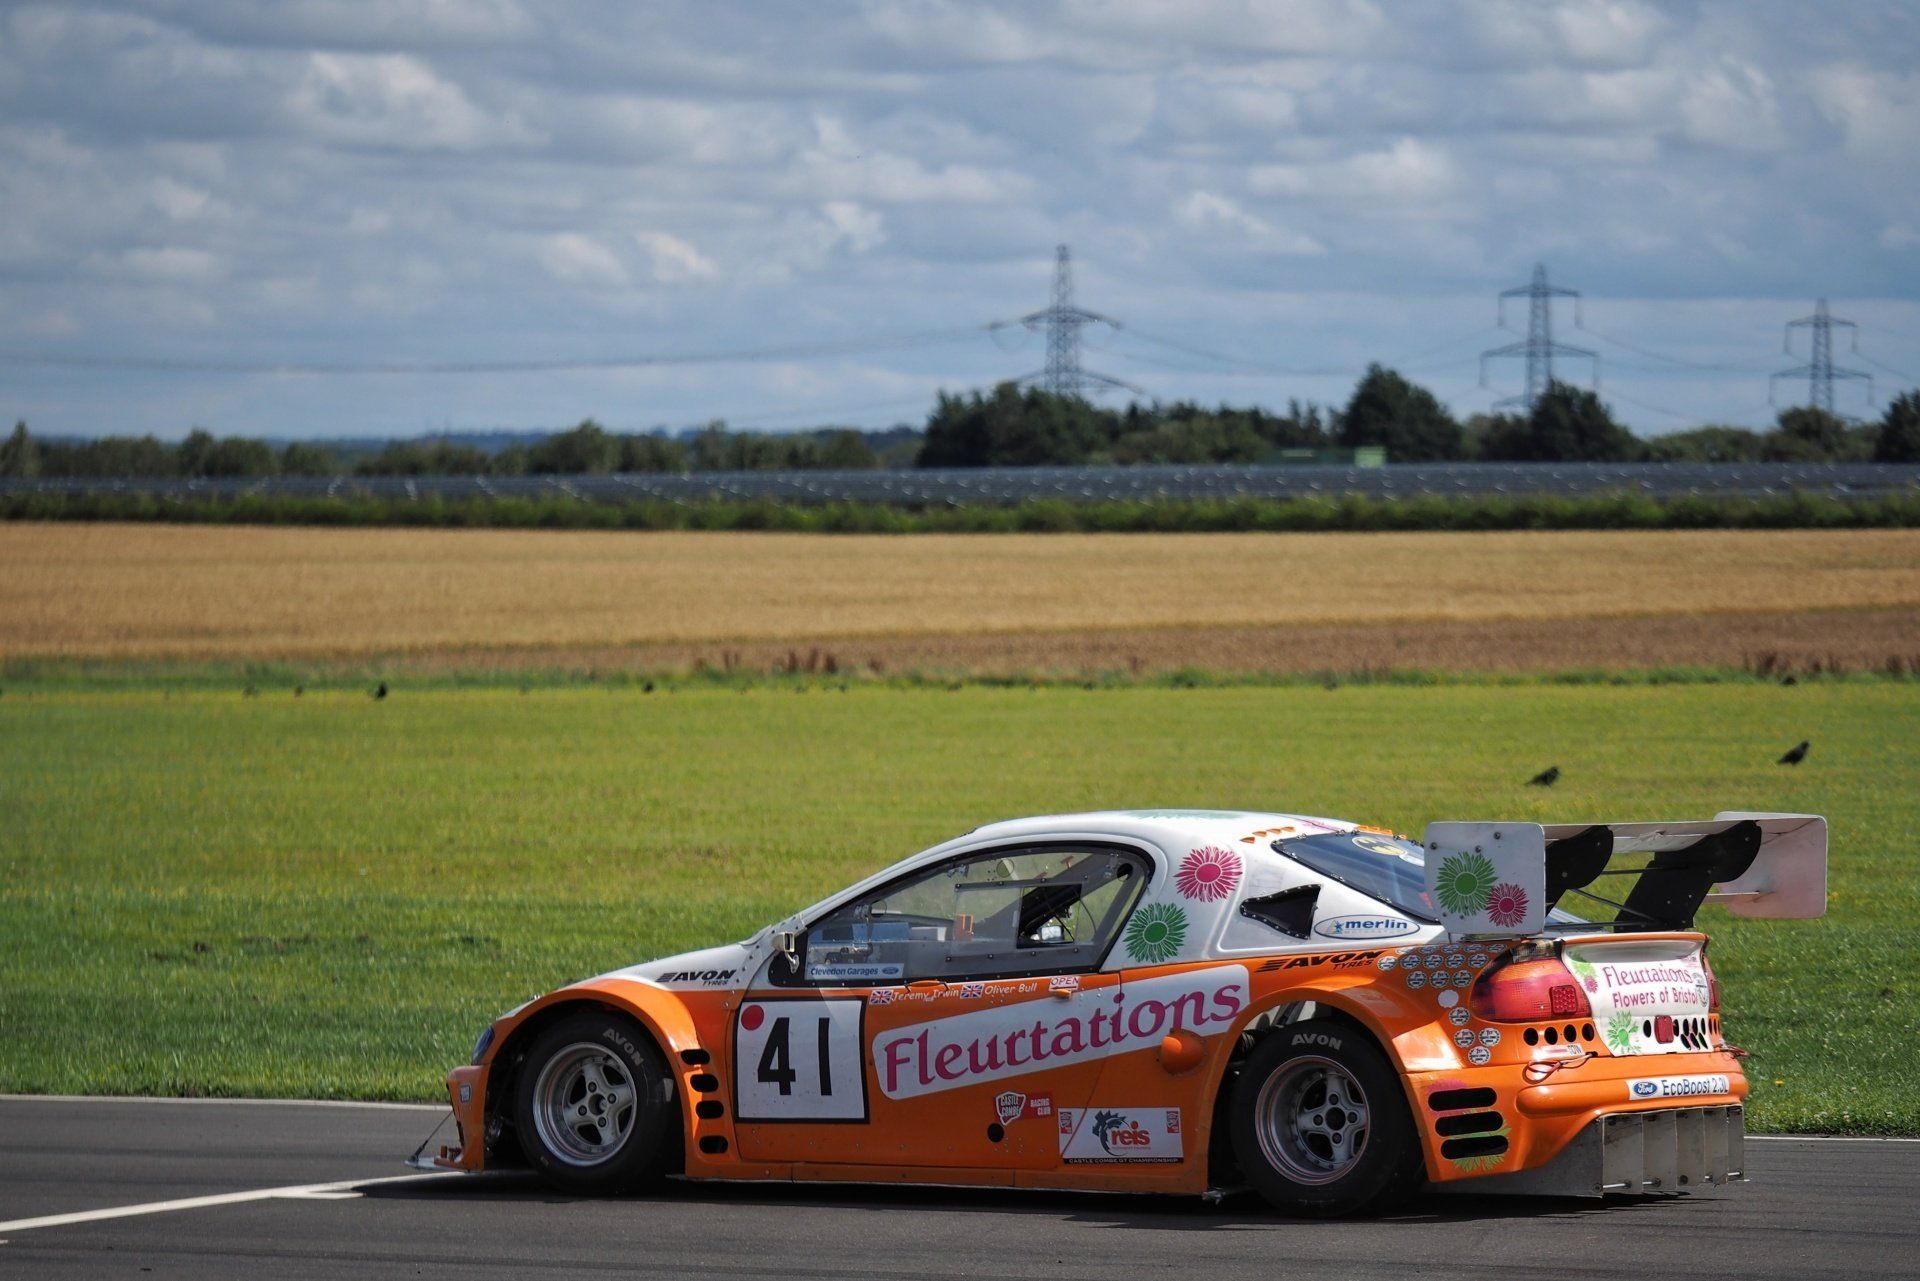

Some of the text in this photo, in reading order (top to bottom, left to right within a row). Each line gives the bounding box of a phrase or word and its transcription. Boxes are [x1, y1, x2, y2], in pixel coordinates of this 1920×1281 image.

[1345, 919, 1408, 929] merlin
[1283, 950, 1386, 969] AVON
[1333, 959, 1374, 971] TYRES
[673, 969, 738, 982] AVON
[810, 967, 846, 976] Clevedon
[847, 967, 879, 976] Garages
[1603, 963, 1694, 988] Fleurtations
[702, 979, 728, 987] TYRES
[1051, 977, 1079, 986] OPEN
[891, 991, 928, 1002] Jeremy
[932, 989, 960, 999] Irwin
[984, 984, 1016, 995] Oliver
[1018, 982, 1043, 993] Bull
[1612, 991, 1656, 1008] Flowers
[1660, 986, 1669, 1004] of
[1672, 987, 1699, 1005] Bristol
[884, 984, 1242, 1092] Fleurtations
[1291, 1033, 1343, 1050] AVON
[602, 1028, 645, 1067] AVON
[757, 1017, 832, 1096] 41
[1637, 1081, 1654, 1094] Ford
[1661, 1078, 1710, 1096] EcoBoost
[1000, 1095, 1019, 1106] CASTLE
[1030, 1098, 1050, 1108] RACING
[1001, 1106, 1020, 1117] COMBE
[1037, 1106, 1051, 1116] CLUB
[1111, 1120, 1151, 1146] reis
